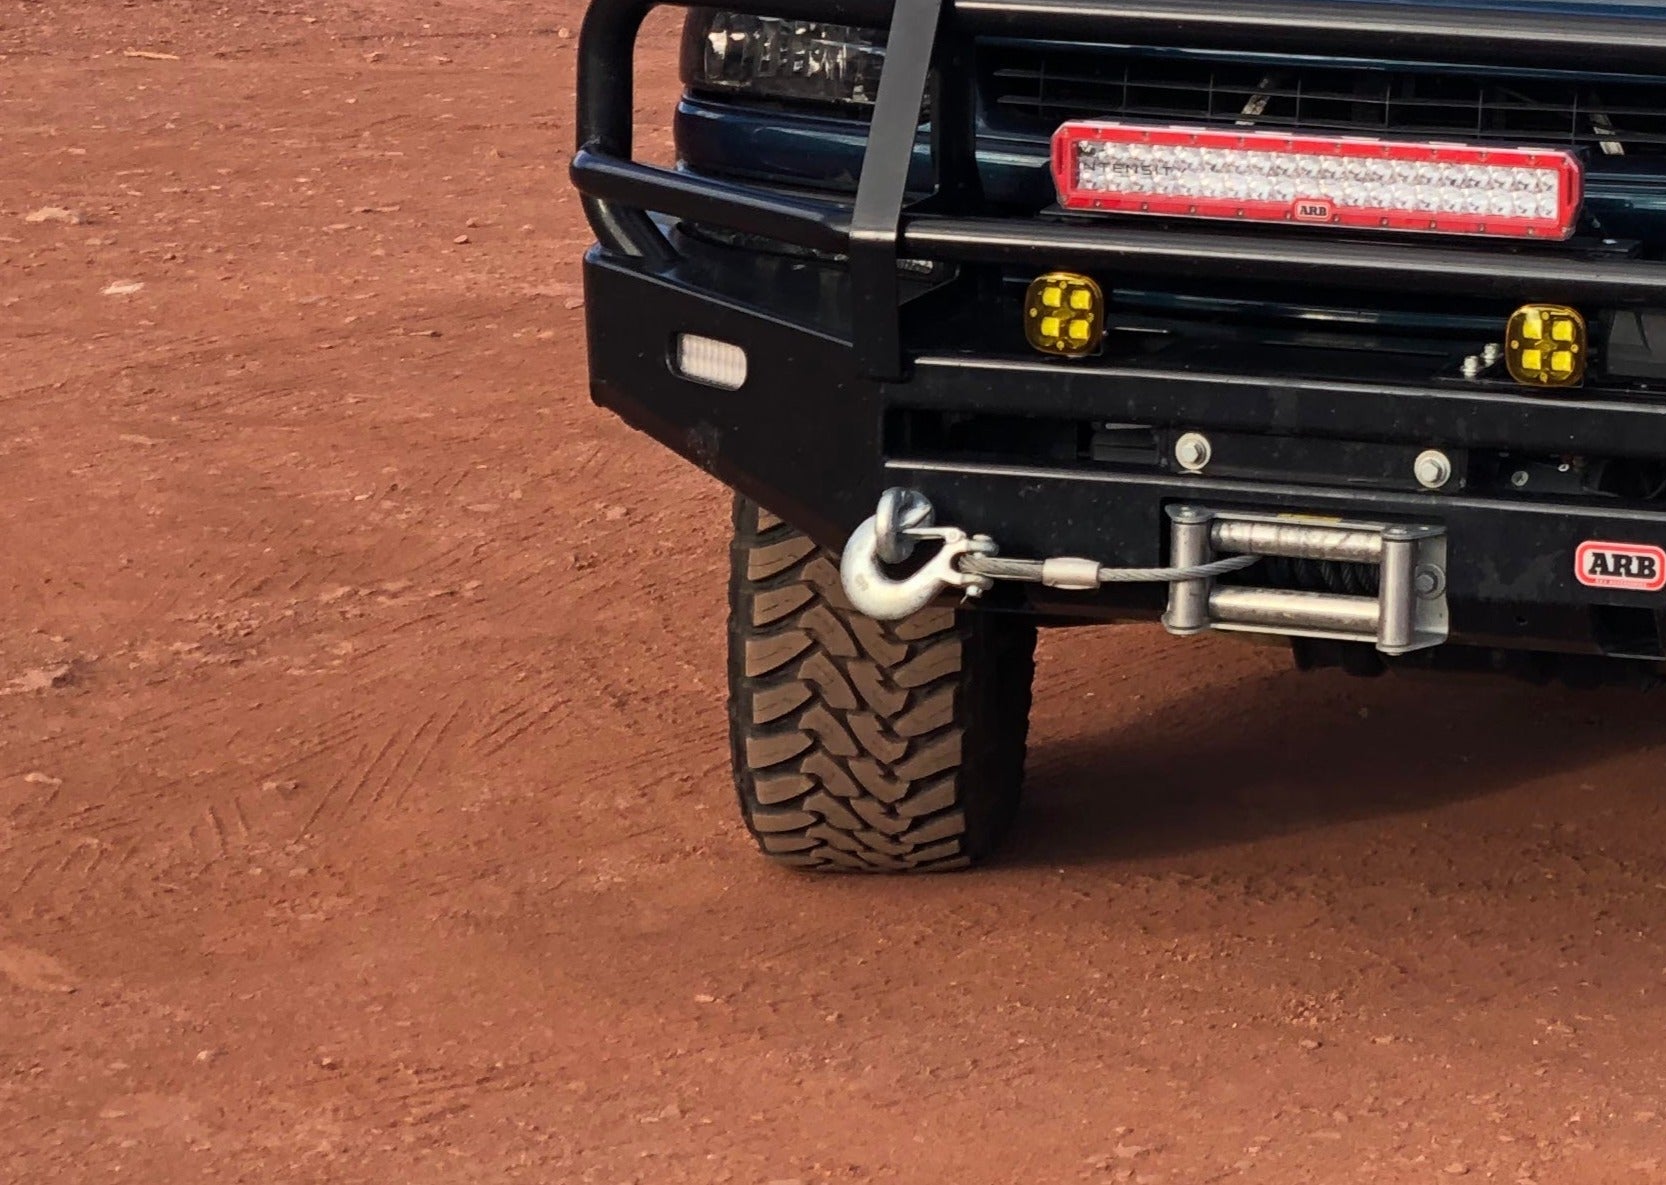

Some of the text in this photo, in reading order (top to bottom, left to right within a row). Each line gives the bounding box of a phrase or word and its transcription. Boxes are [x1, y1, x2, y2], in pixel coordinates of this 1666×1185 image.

[1080, 161, 1188, 176] NTENSITY
[1299, 205, 1328, 217] ARB
[1588, 552, 1657, 579] ARB
